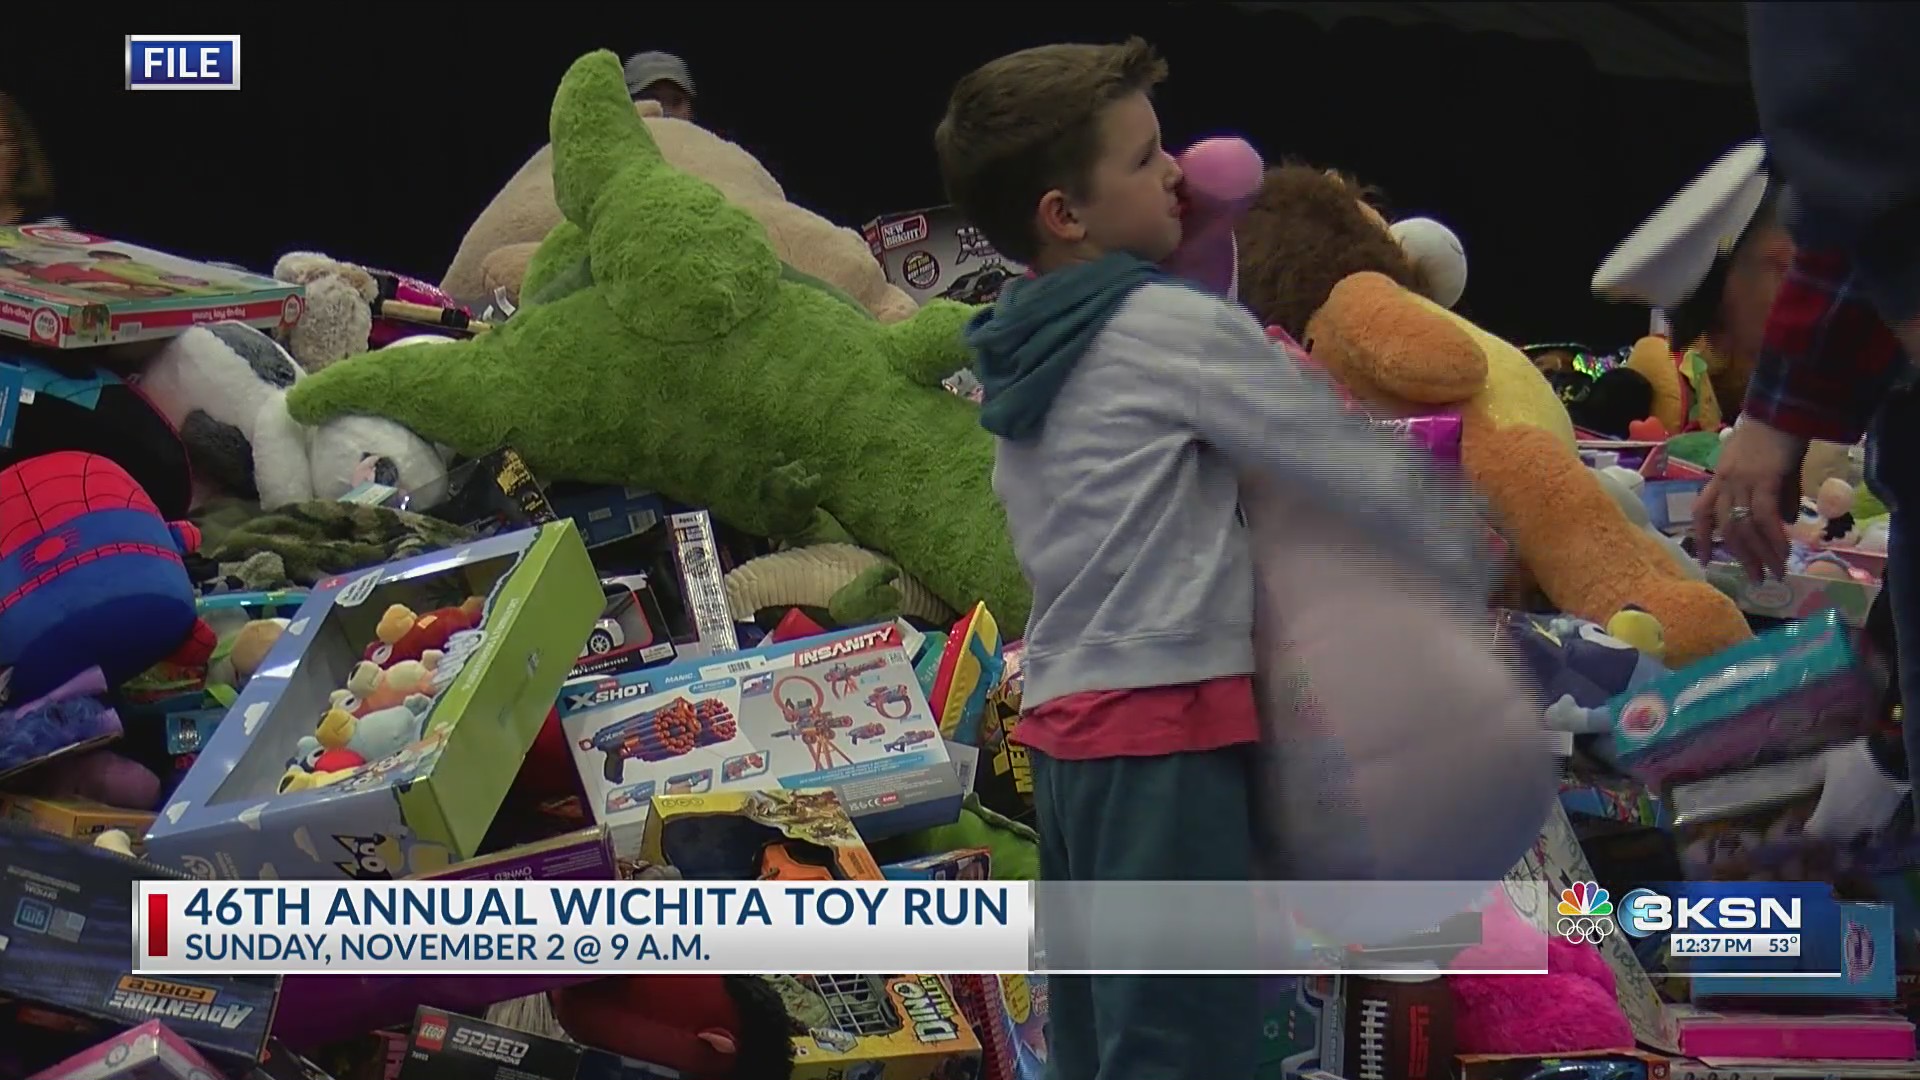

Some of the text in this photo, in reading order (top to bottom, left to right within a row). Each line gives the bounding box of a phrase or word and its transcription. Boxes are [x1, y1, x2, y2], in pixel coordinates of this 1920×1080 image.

[884, 223, 905, 237] NEW
[885, 228, 920, 246] BRIGHT
[798, 627, 895, 667] INSANITY
[665, 672, 694, 685] MANIC
[127, 979, 206, 1000] FORCE
[109, 991, 256, 1030] ADVENTURE
[892, 981, 958, 1043] DINO
[420, 1022, 447, 1041] LEGO
[452, 1027, 530, 1058] SPEED
